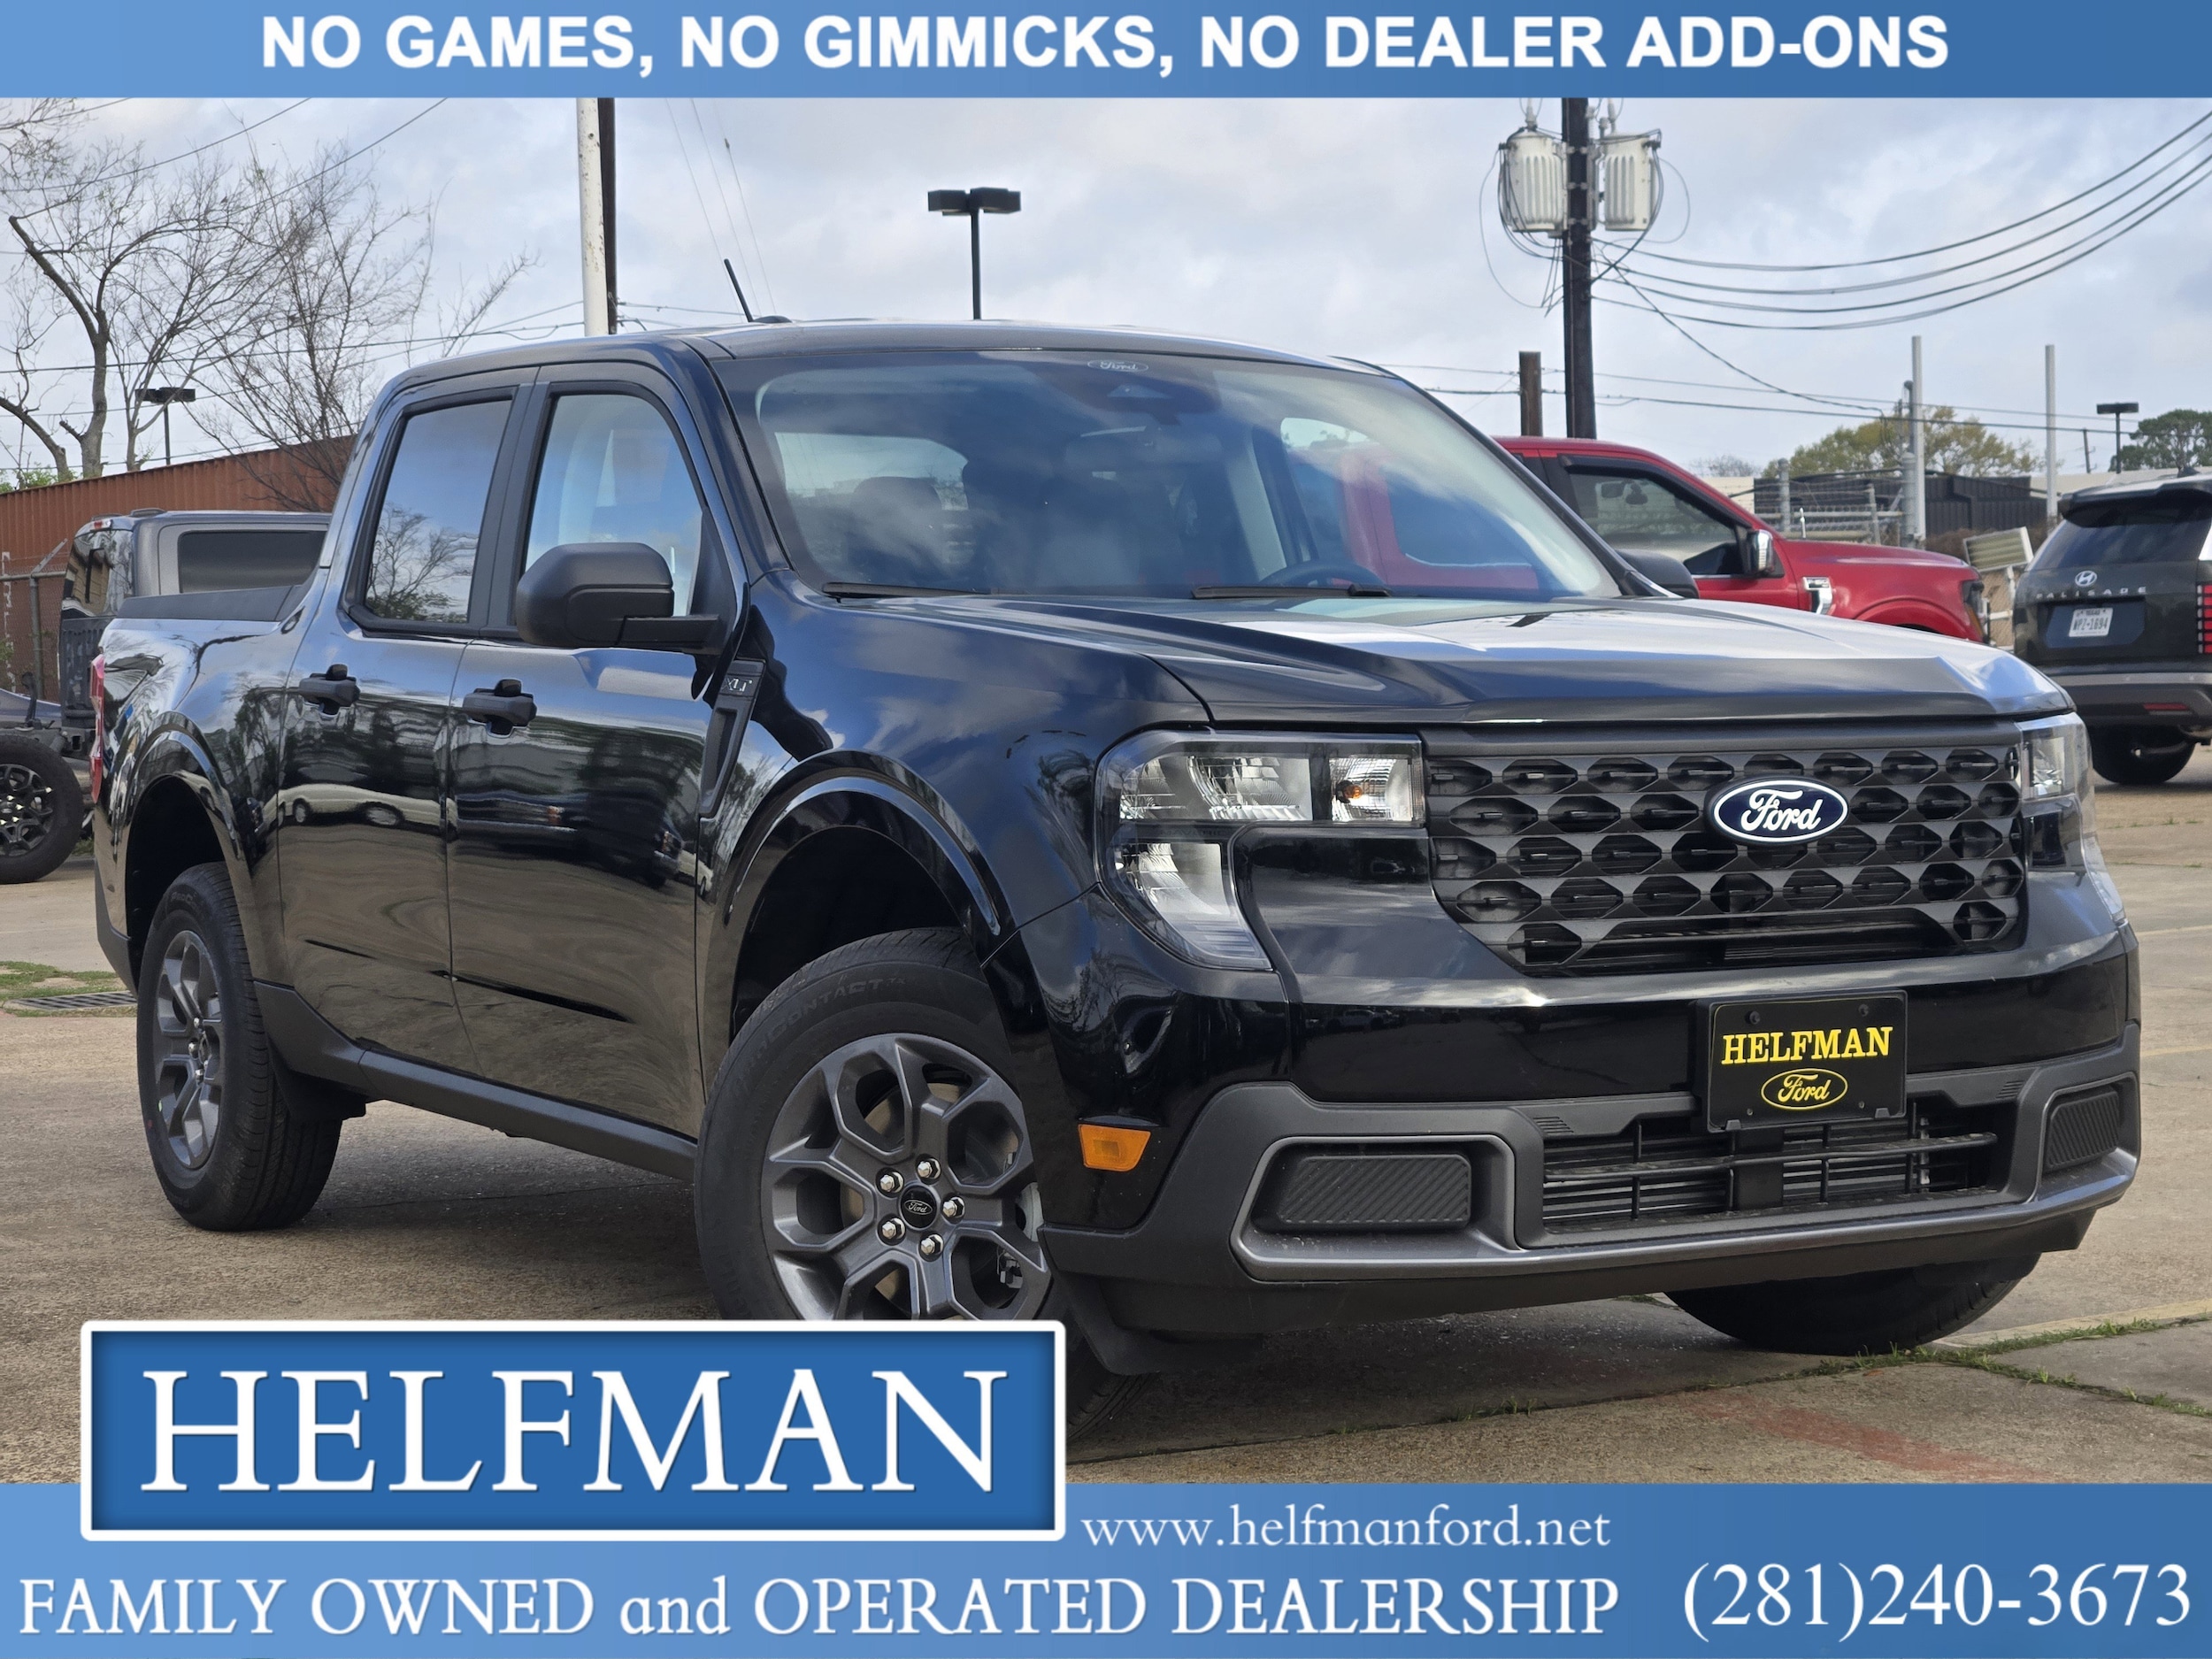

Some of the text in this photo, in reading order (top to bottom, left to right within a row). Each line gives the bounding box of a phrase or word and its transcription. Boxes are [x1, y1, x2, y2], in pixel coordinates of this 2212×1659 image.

[1100, 361, 1138, 371] Ford
[2036, 587, 2147, 599] PALISADE
[1740, 788, 1824, 832] Ford
[1721, 1026, 1893, 1064] HELFMAN
[1778, 1073, 1832, 1102] Ford
[908, 1202, 928, 1213] Ford
